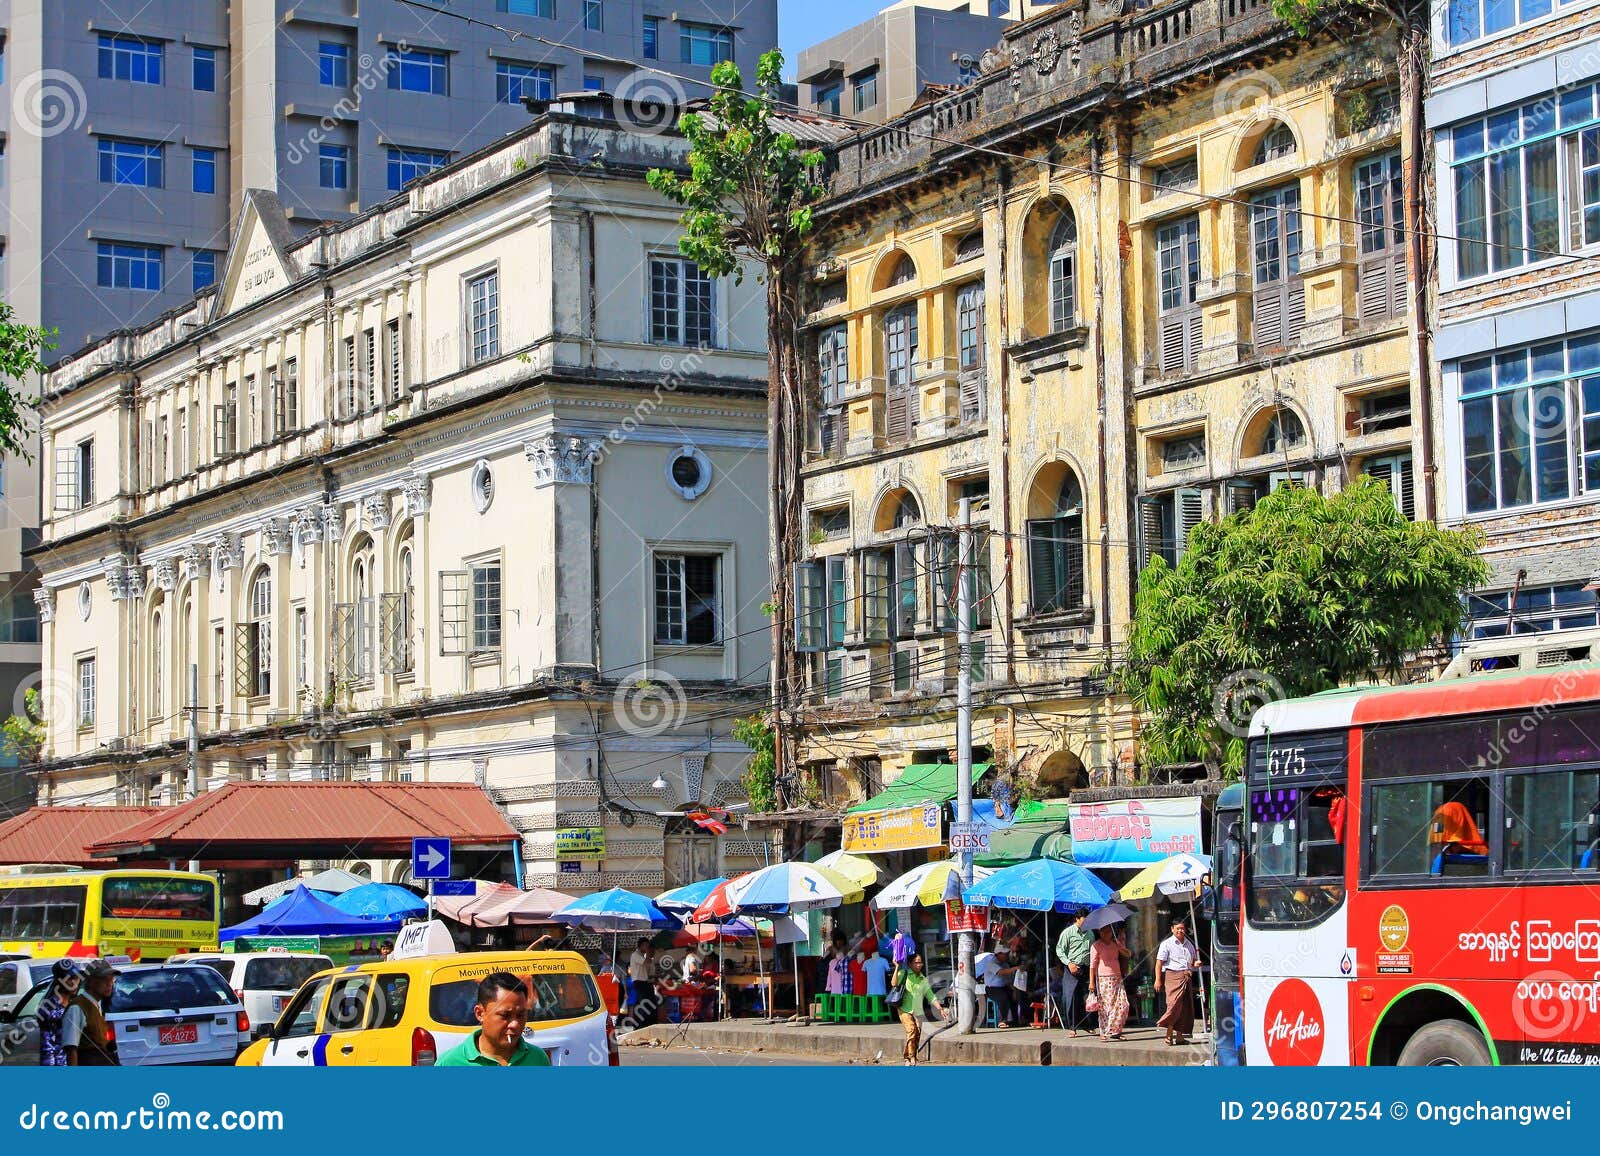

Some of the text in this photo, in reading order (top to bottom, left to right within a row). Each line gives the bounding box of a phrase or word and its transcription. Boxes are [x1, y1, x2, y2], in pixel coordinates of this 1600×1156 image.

[1269, 748, 1305, 775] 675
[951, 834, 988, 847] GESC
[1006, 895, 1042, 906] telenor
[459, 963, 566, 977] Moving Myanmar Forward
[1520, 1047, 1600, 1066] We'll take yo
